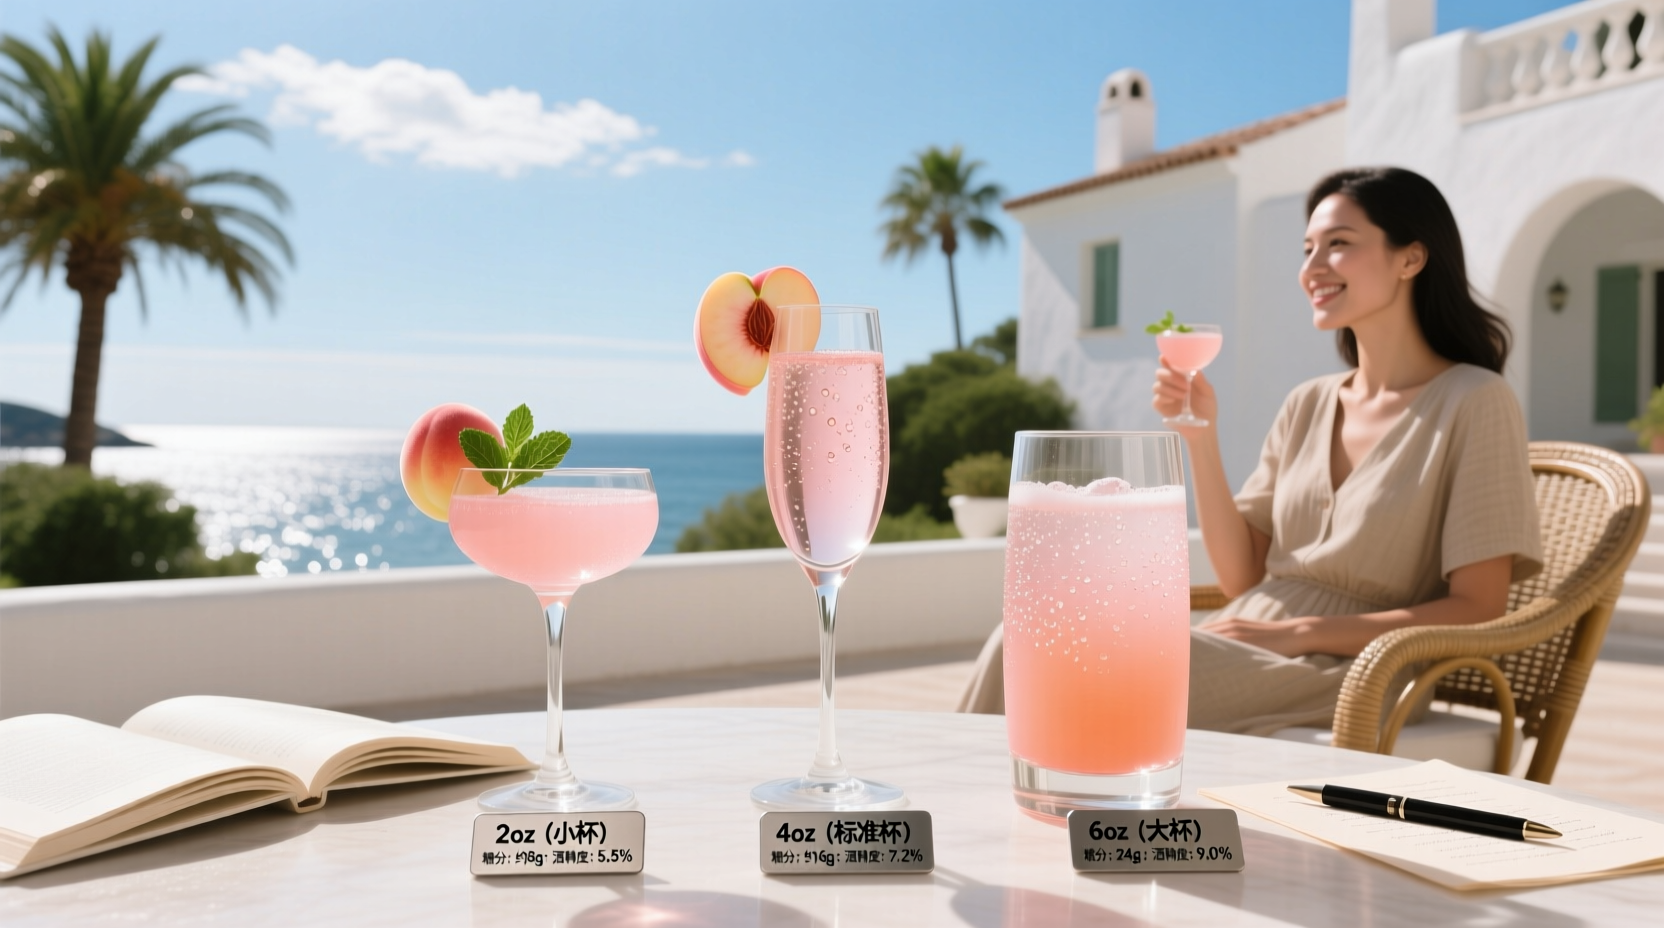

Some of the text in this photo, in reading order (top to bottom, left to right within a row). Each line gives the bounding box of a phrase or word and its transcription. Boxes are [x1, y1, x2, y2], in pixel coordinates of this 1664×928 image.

[495, 819, 607, 846] 2oz (小杯)
[776, 819, 911, 845] 4oz (标准杯)
[1088, 817, 1202, 844] 6oz (大杯)
[597, 848, 634, 864] 5.5%
[888, 848, 924, 863] 7.2%
[1196, 846, 1233, 861] 9.0%
